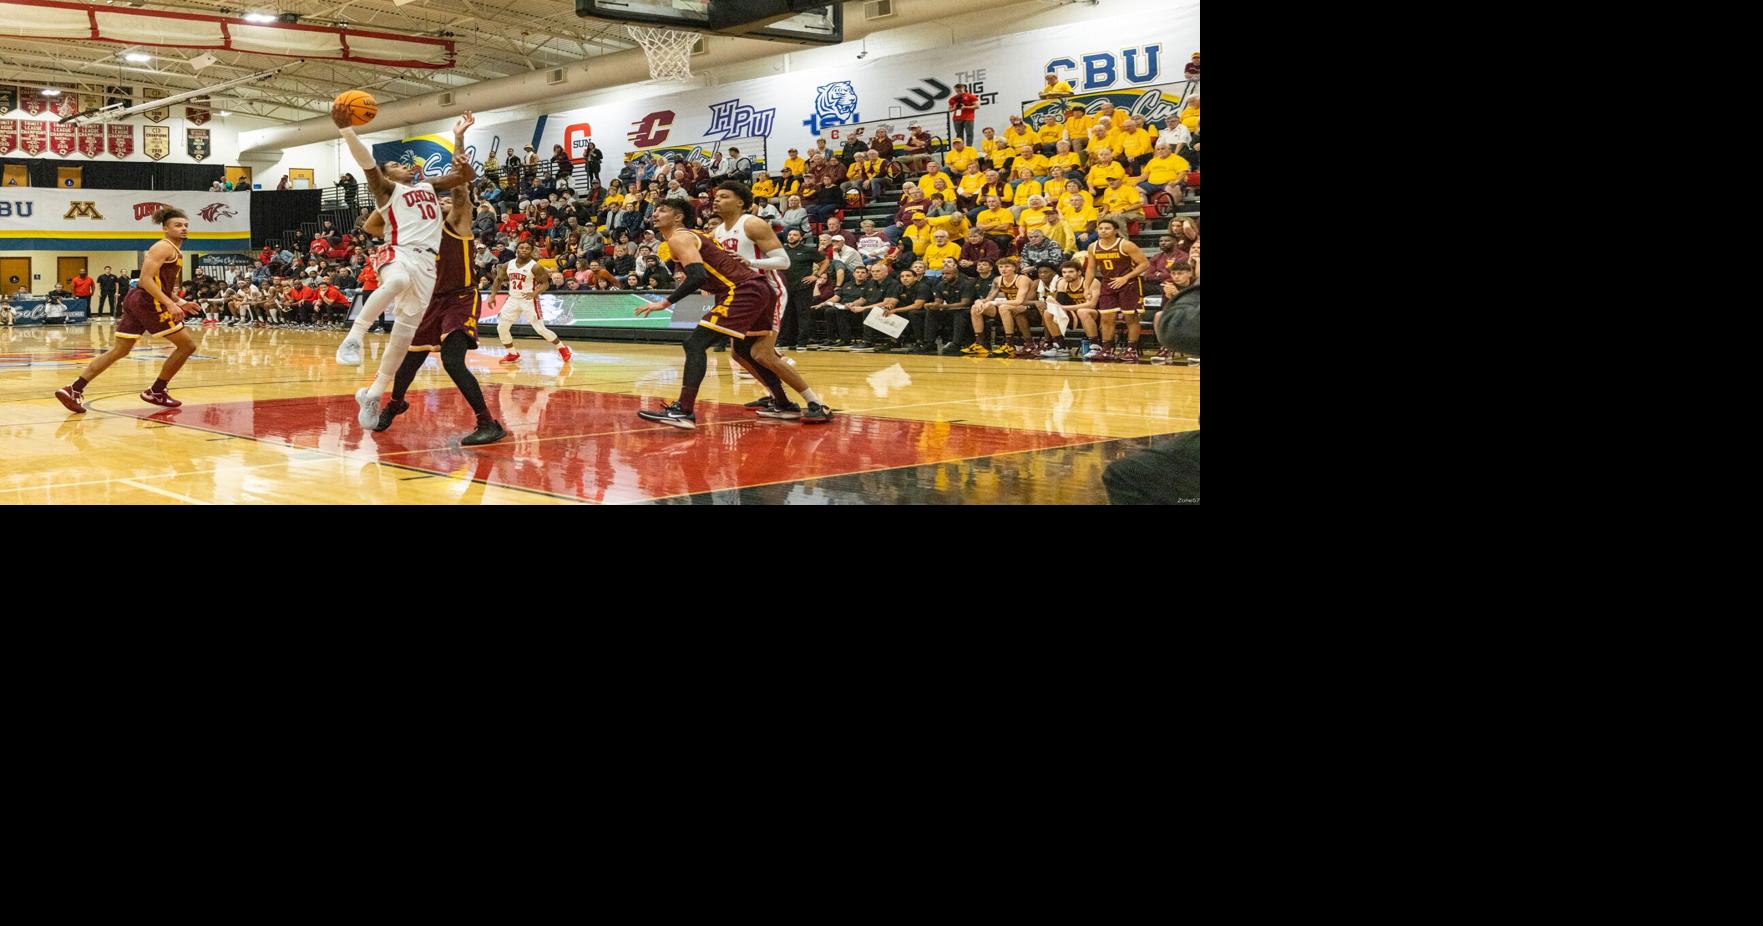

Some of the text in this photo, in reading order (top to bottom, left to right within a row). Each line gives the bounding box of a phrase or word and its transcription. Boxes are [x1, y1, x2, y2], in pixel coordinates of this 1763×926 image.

[1045, 42, 1162, 92] CBU
[955, 69, 987, 83] THE
[703, 98, 777, 142] HPU
[417, 203, 436, 220] 10
[1103, 259, 1114, 270] 0
[512, 281, 523, 290] 24
